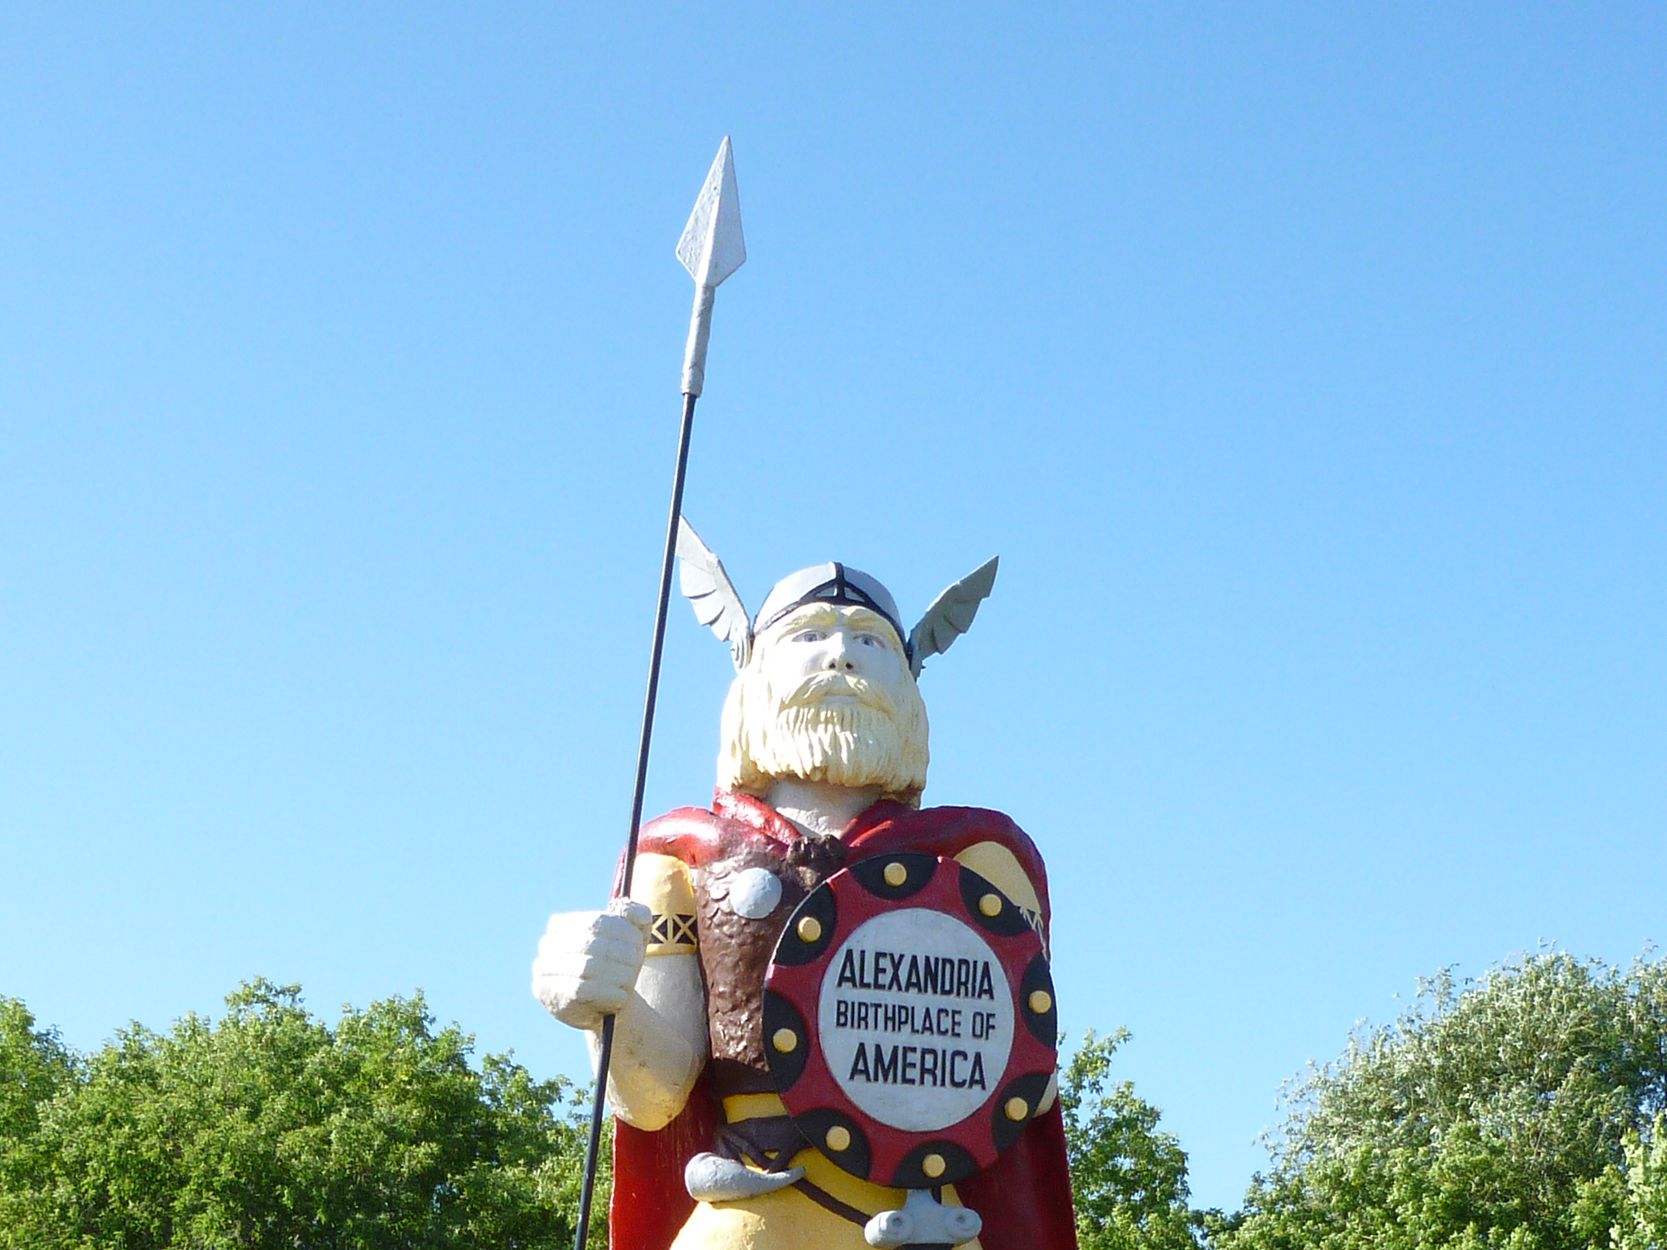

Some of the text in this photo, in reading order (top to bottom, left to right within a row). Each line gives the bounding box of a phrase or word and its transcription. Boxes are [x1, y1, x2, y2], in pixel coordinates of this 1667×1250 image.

[837, 949, 994, 1000] ALEXANDRIA
[836, 1000, 996, 1040] BIRTHPLACE OF
[849, 1042, 986, 1090] AMERICA
